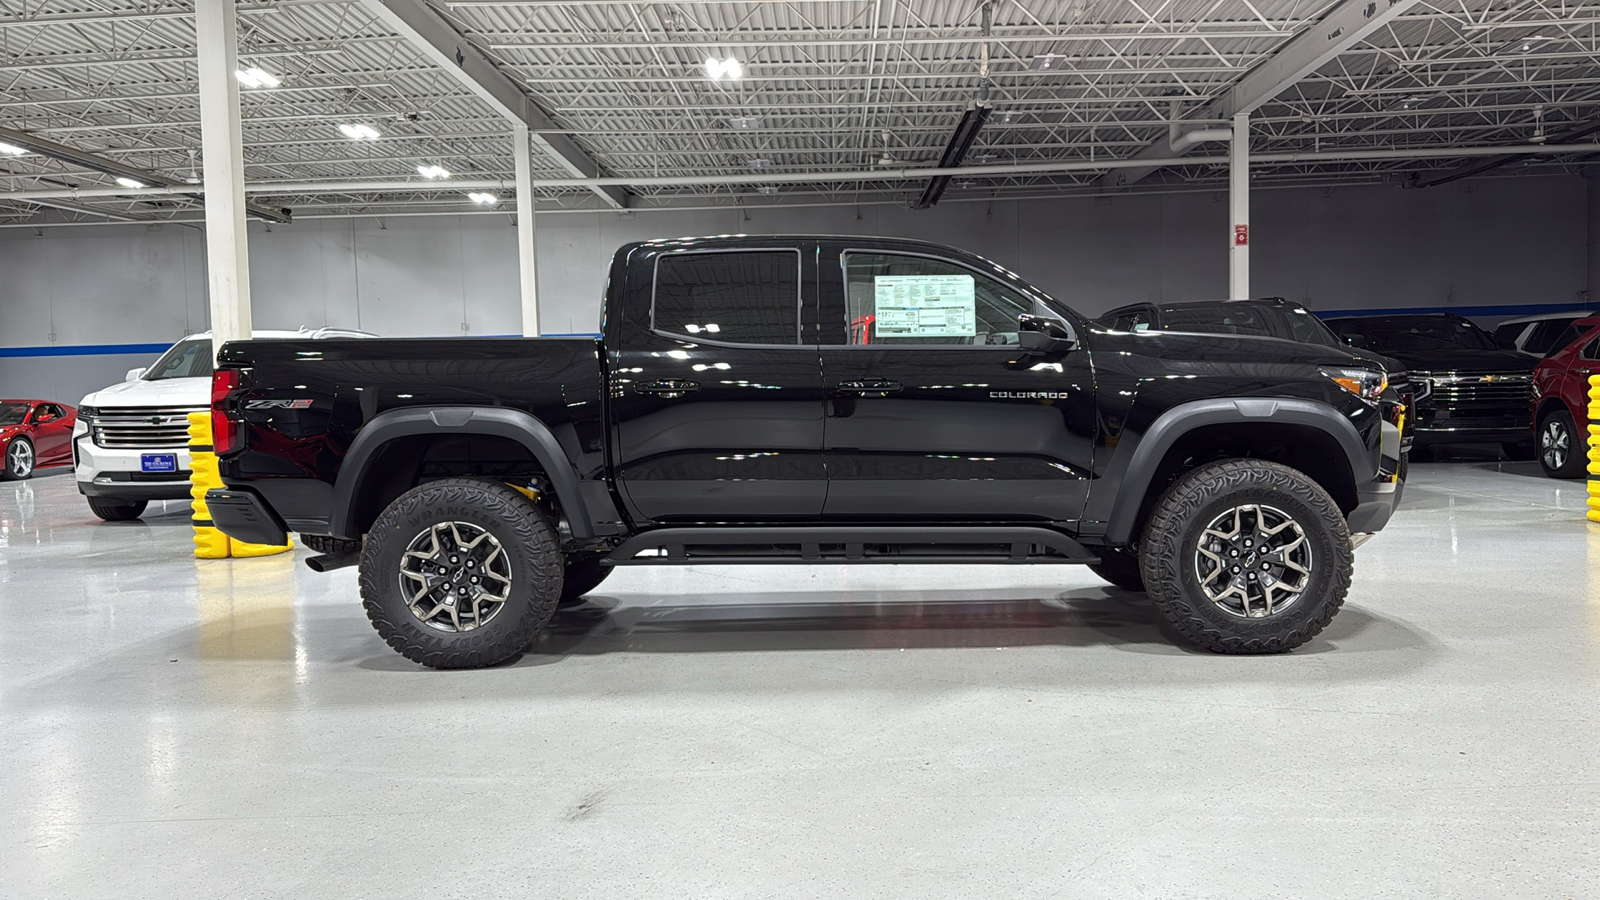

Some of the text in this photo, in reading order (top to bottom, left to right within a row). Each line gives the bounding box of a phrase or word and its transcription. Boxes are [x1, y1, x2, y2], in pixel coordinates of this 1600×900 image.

[989, 391, 1068, 399] COLORADO
[245, 399, 314, 409] ZR2
[407, 506, 502, 530] WRANGLER
